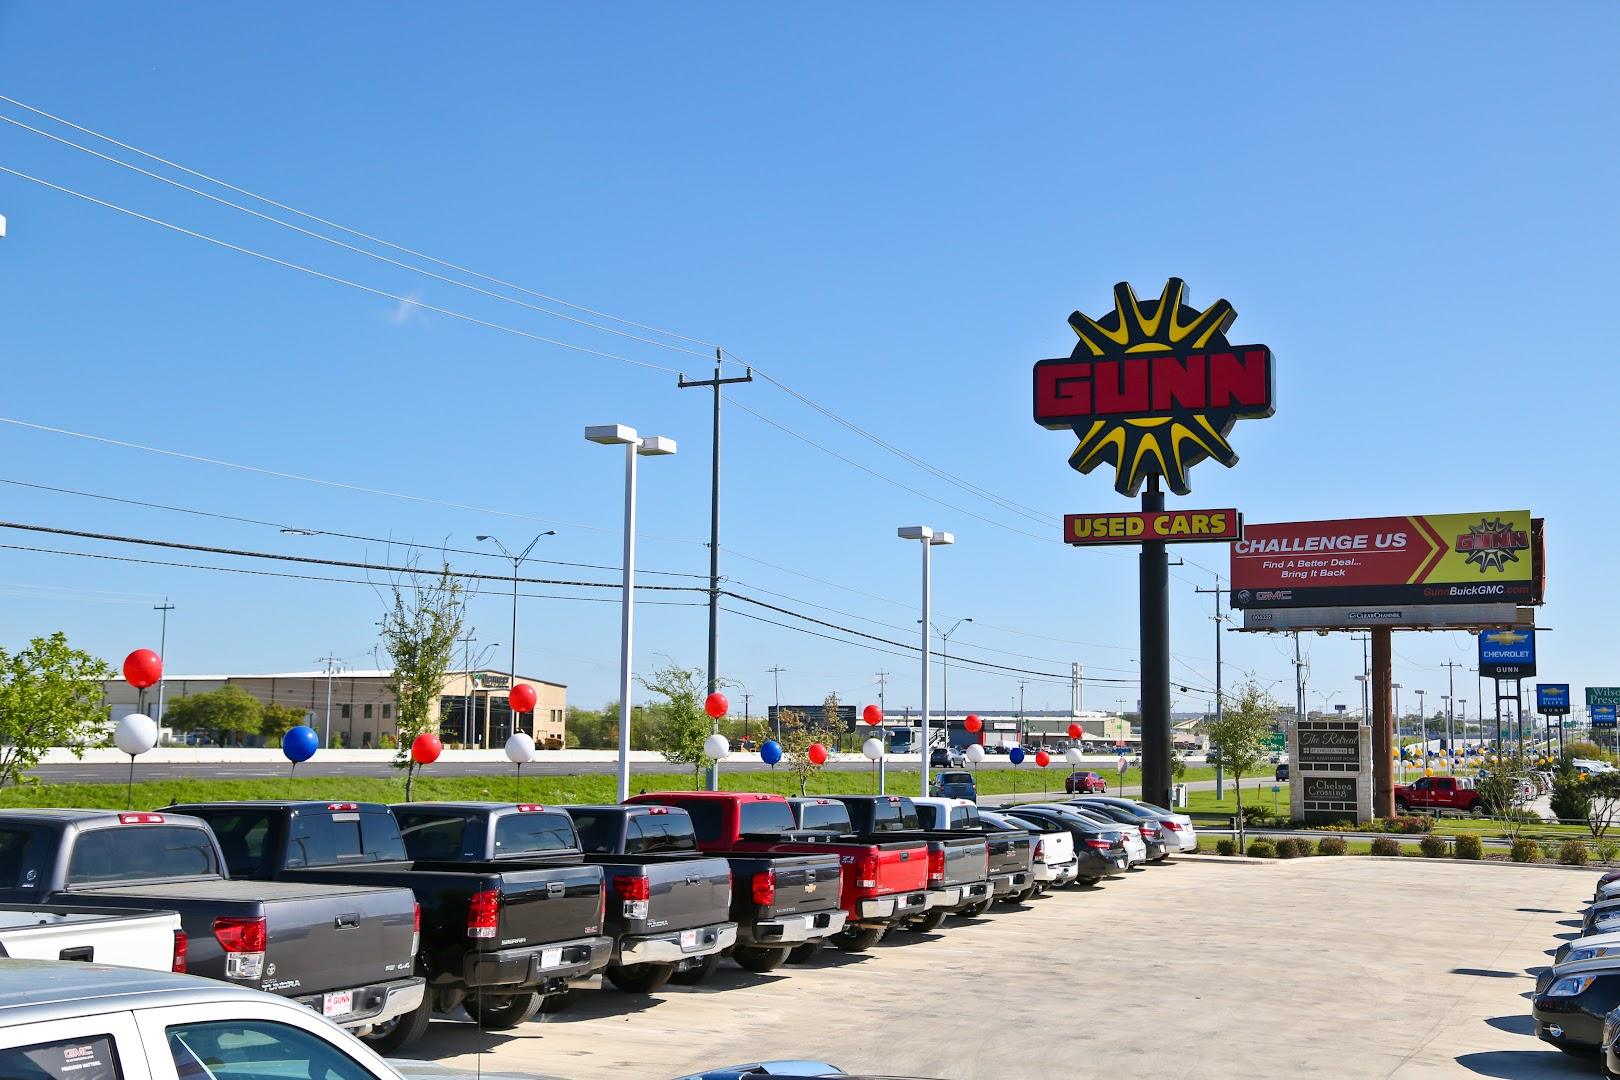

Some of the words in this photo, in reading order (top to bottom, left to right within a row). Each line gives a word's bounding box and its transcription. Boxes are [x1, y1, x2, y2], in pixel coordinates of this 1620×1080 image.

[1036, 350, 1266, 418] GUNN
[1073, 516, 1145, 538] USED
[1153, 513, 1226, 536] CARS
[1234, 534, 1369, 554] CHALLENGE
[1375, 532, 1408, 548] US
[1457, 531, 1529, 550] GUNN
[1262, 560, 1285, 570] Find
[1286, 559, 1295, 568] A
[1297, 559, 1328, 568] Better
[1330, 558, 1362, 567] Deal...
[1280, 570, 1308, 579] Bring
[1310, 569, 1319, 577] It
[1320, 569, 1346, 577] Back
[1256, 590, 1292, 601] GMC
[1483, 650, 1530, 659] CHEVROLET
[1301, 732, 1319, 745] The
[1322, 732, 1358, 745] Retreat
[1316, 780, 1352, 790] Chelsea
[1308, 785, 1347, 798] Crossing
[261, 979, 301, 991] TUNDRA
[333, 994, 350, 1005] GUNN
[64, 1045, 94, 1058] GMC
